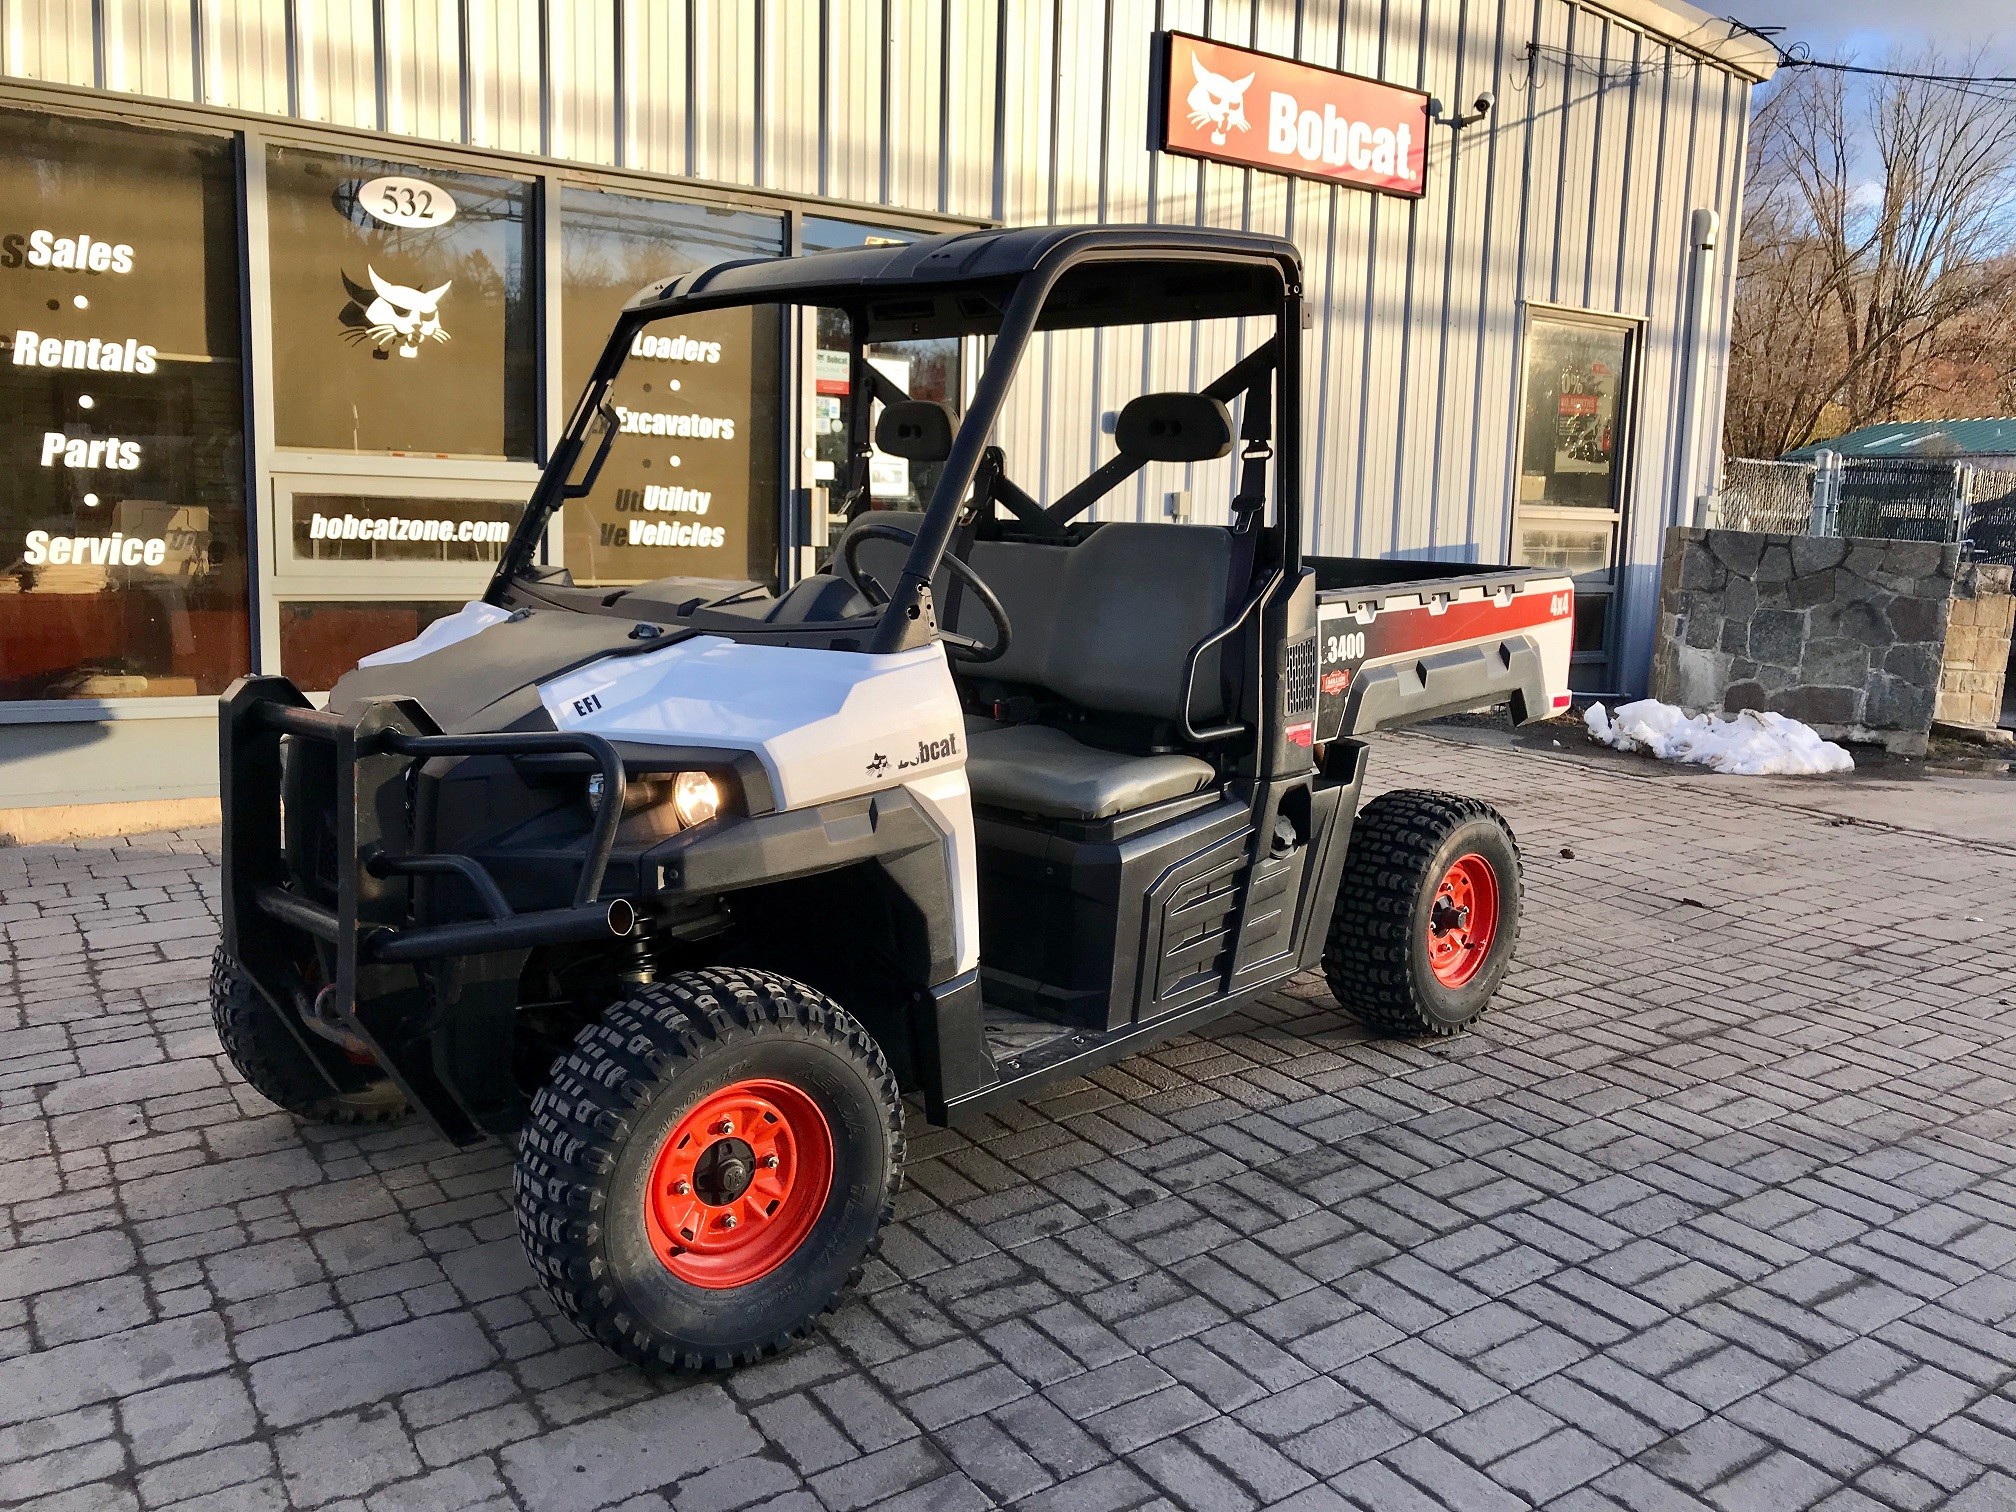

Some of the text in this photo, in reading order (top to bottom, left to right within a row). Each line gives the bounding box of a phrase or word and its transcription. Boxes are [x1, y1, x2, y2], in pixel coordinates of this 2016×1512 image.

[1268, 91, 1411, 179] Bobcat
[381, 185, 436, 219] 532
[27, 230, 134, 274] Sales
[12, 330, 157, 375] Rentals
[631, 331, 722, 363] Loaders
[615, 407, 735, 440] Excavators
[40, 432, 141, 471] Parts
[643, 485, 711, 515] Utility
[310, 513, 510, 543] bobcatzone.com
[628, 520, 726, 548] Vehicles
[24, 530, 166, 566] Service
[1550, 593, 1569, 617] 4x4
[1327, 631, 1365, 663] 3400
[573, 694, 602, 717] EFI
